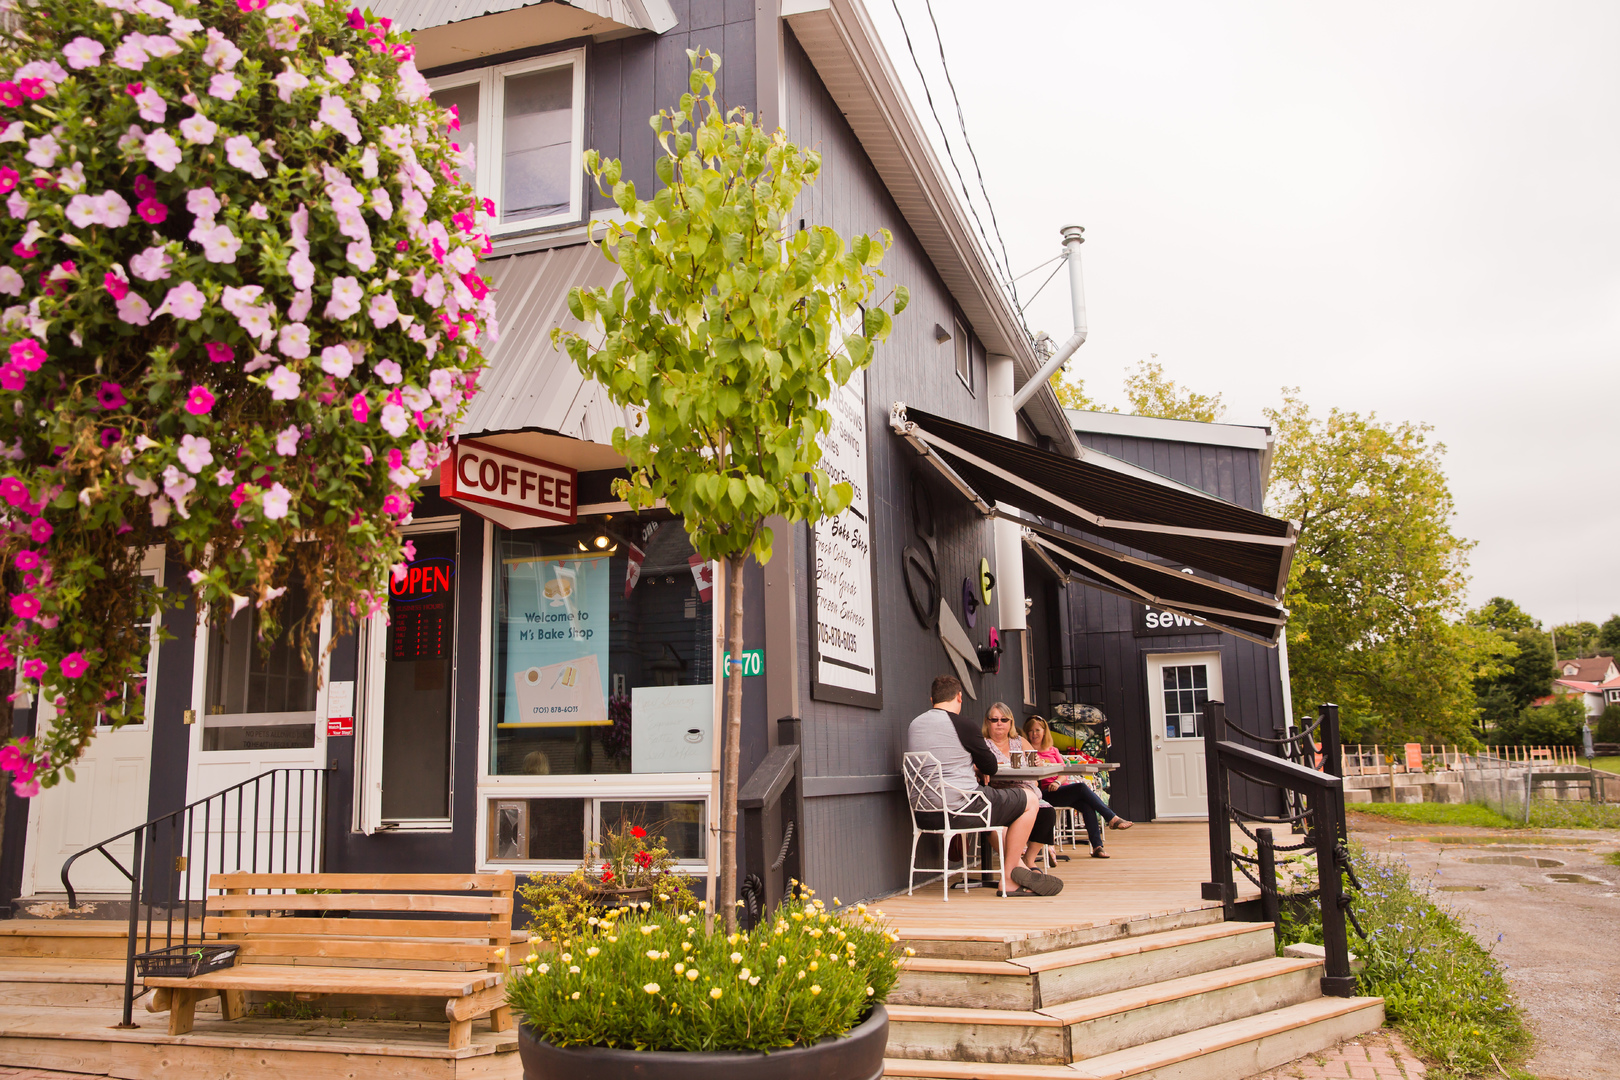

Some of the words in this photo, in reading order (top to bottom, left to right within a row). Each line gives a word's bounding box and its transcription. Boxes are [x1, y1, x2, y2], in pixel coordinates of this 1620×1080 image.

[816, 430, 839, 457] upplies
[839, 421, 860, 458] Sewing
[458, 453, 571, 510] COFFEE
[815, 456, 840, 483] utdoor
[815, 531, 832, 556] Fresh
[832, 543, 852, 568] Coffee
[832, 515, 850, 541] Bake
[851, 528, 868, 560] Shop
[390, 565, 450, 595] OPEN
[816, 557, 837, 585] Baked
[839, 571, 857, 599] Goods
[396, 604, 422, 612] BUSINESS
[525, 612, 575, 623] Welcome
[577, 610, 589, 621] to
[816, 586, 838, 614] Frozen
[839, 601, 865, 628] Entrees
[519, 629, 534, 641] M's
[538, 628, 565, 640] Bake
[568, 627, 594, 640] Shop
[817, 621, 857, 653] 705-878-6035
[724, 652, 760, 676] 670
[533, 706, 549, 714] (705)
[550, 705, 579, 714] 878-6035
[245, 730, 255, 738] NO
[255, 730, 269, 738] PETS
